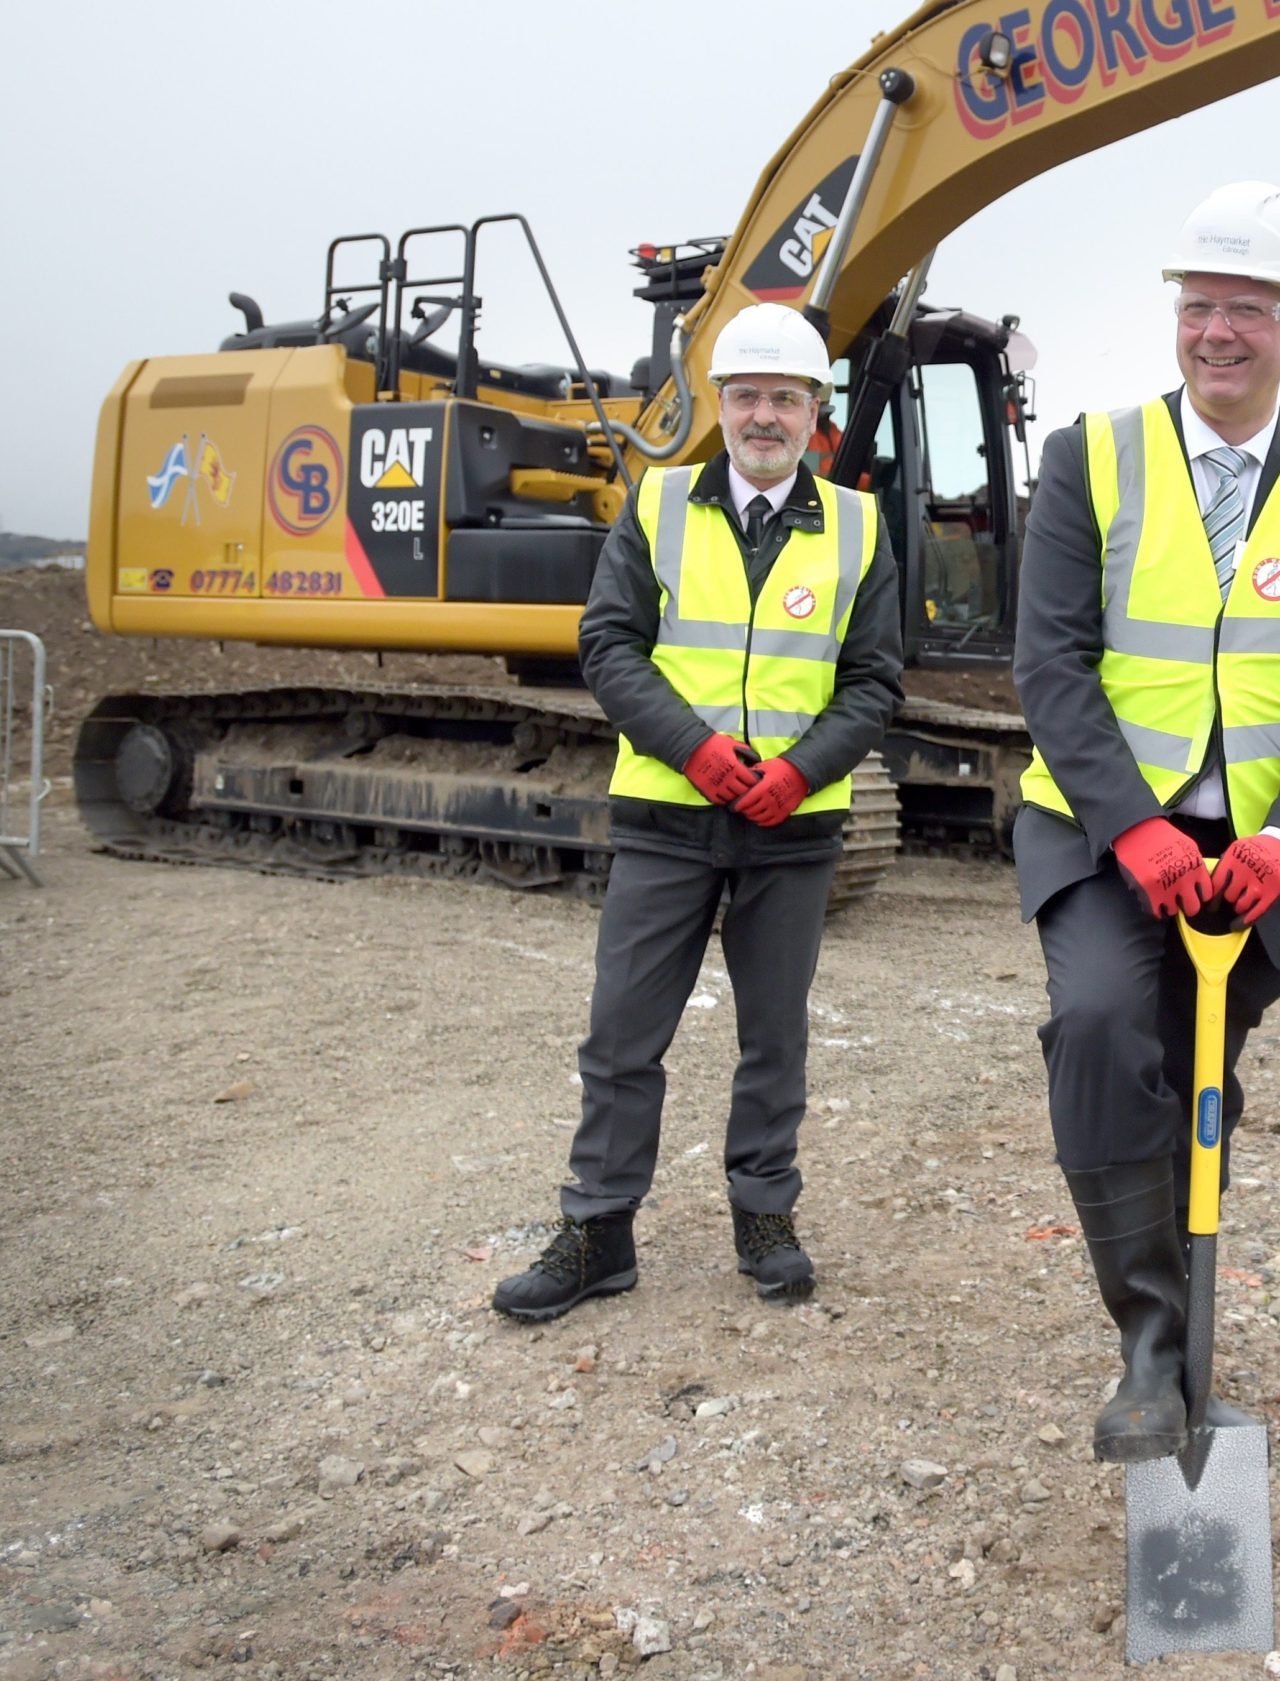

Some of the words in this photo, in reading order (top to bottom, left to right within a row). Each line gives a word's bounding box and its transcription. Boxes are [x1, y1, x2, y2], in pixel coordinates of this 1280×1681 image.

[779, 193, 839, 277] CAT
[360, 427, 433, 488] CAT
[371, 500, 425, 532] 320E
[413, 537, 424, 560] L
[190, 569, 256, 593] 07774
[265, 570, 342, 595] 482831
